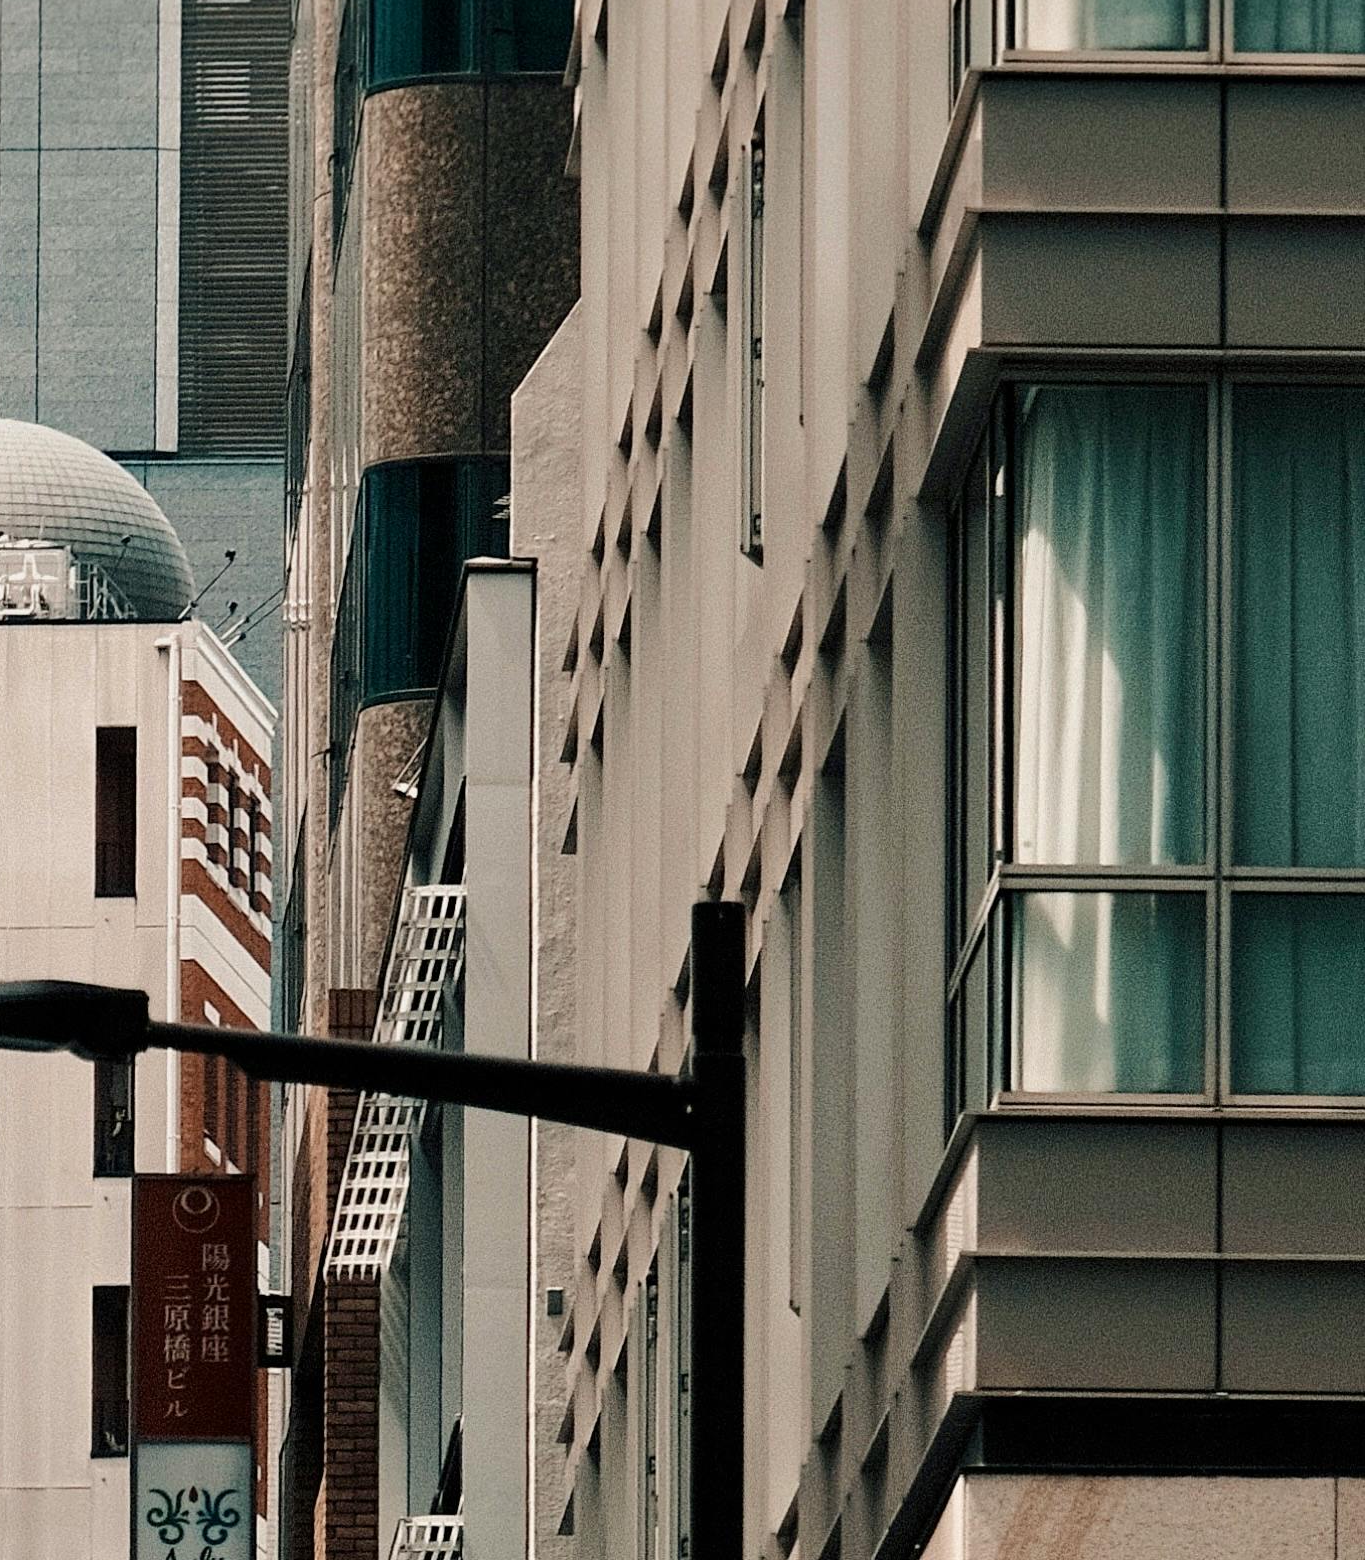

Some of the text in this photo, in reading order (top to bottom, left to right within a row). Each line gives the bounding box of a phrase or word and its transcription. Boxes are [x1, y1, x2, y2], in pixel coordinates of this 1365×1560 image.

[163, 1274, 192, 1418] 三原橋ビル
[201, 1243, 231, 1363] 陽光銀座
